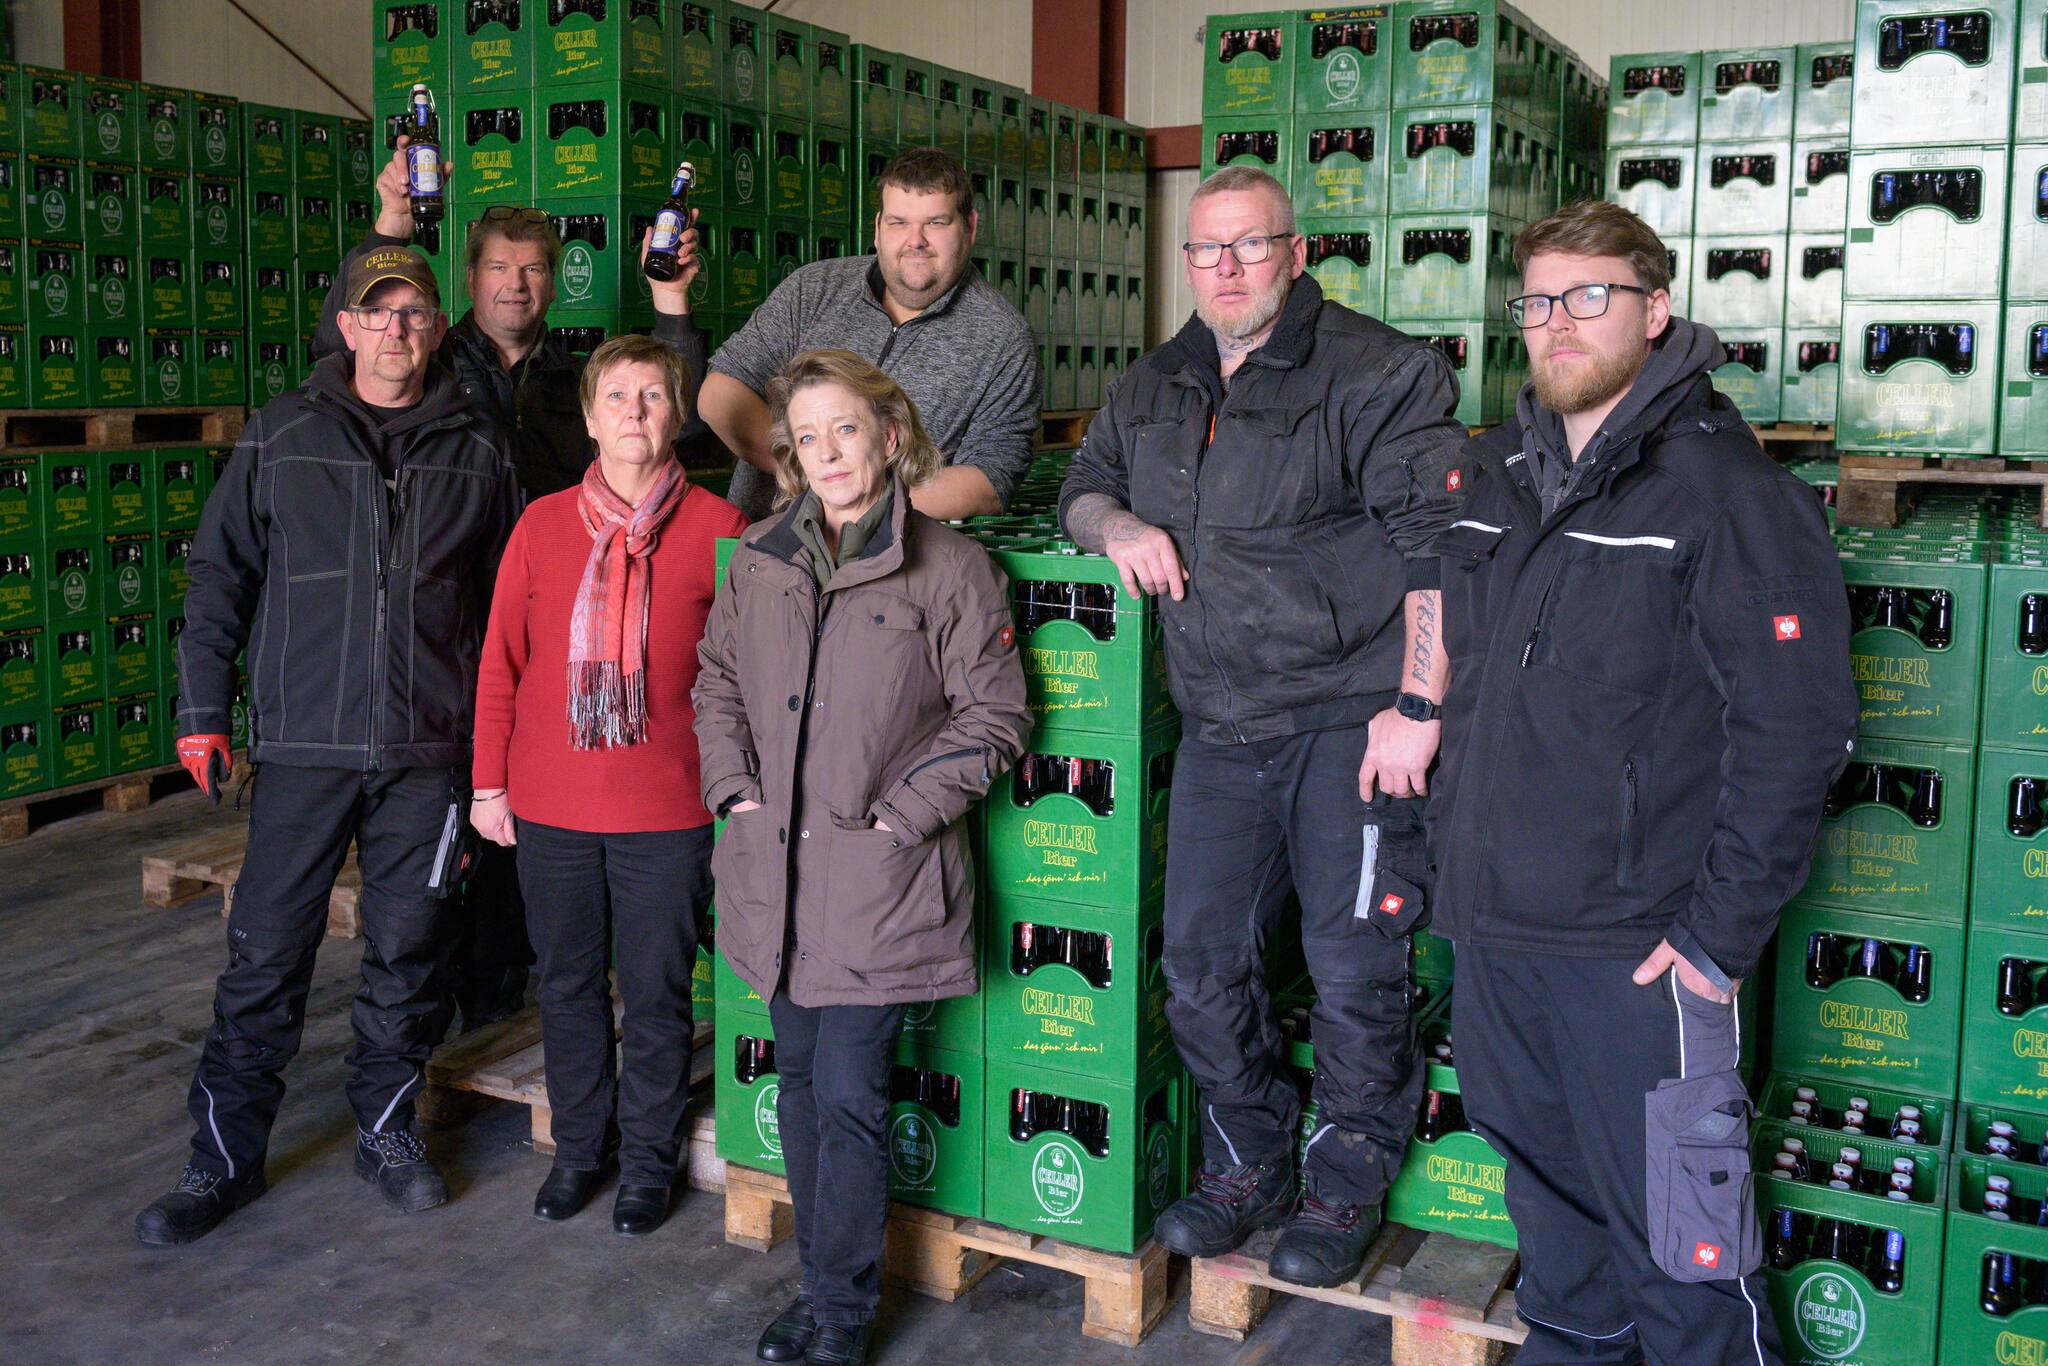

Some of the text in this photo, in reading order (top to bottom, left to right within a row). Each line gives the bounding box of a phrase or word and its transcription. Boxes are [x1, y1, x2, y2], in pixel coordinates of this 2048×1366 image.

[471, 39, 512, 60] CELLER
[554, 29, 598, 51] CELLER
[472, 150, 512, 169] CELLER
[554, 144, 598, 165] CELLER
[366, 252, 410, 268] CELLER
[377, 261, 399, 270] Bier
[1876, 382, 1955, 409] CELLER
[1025, 648, 1099, 679] CELLER
[1044, 677, 1079, 694] Bier
[1862, 684, 1904, 701] Bier
[1024, 819, 1098, 855] CELLER
[1828, 827, 1919, 864] CELLER
[1043, 850, 1077, 868] Bier
[1852, 859, 1894, 878] Bier
[1022, 987, 1095, 1025] CELLER
[1041, 1018, 1075, 1037] Bier
[1820, 1000, 1909, 1040] CELLER
[1842, 1032, 1884, 1051] Bier
[1038, 1167, 1079, 1192] CELLER
[1427, 1154, 1505, 1195] CELLER
[1048, 1186, 1069, 1198] Bier
[1448, 1185, 1485, 1206] Bier
[1801, 1300, 1857, 1331] CELLER
[1816, 1322, 1844, 1337] Bier
